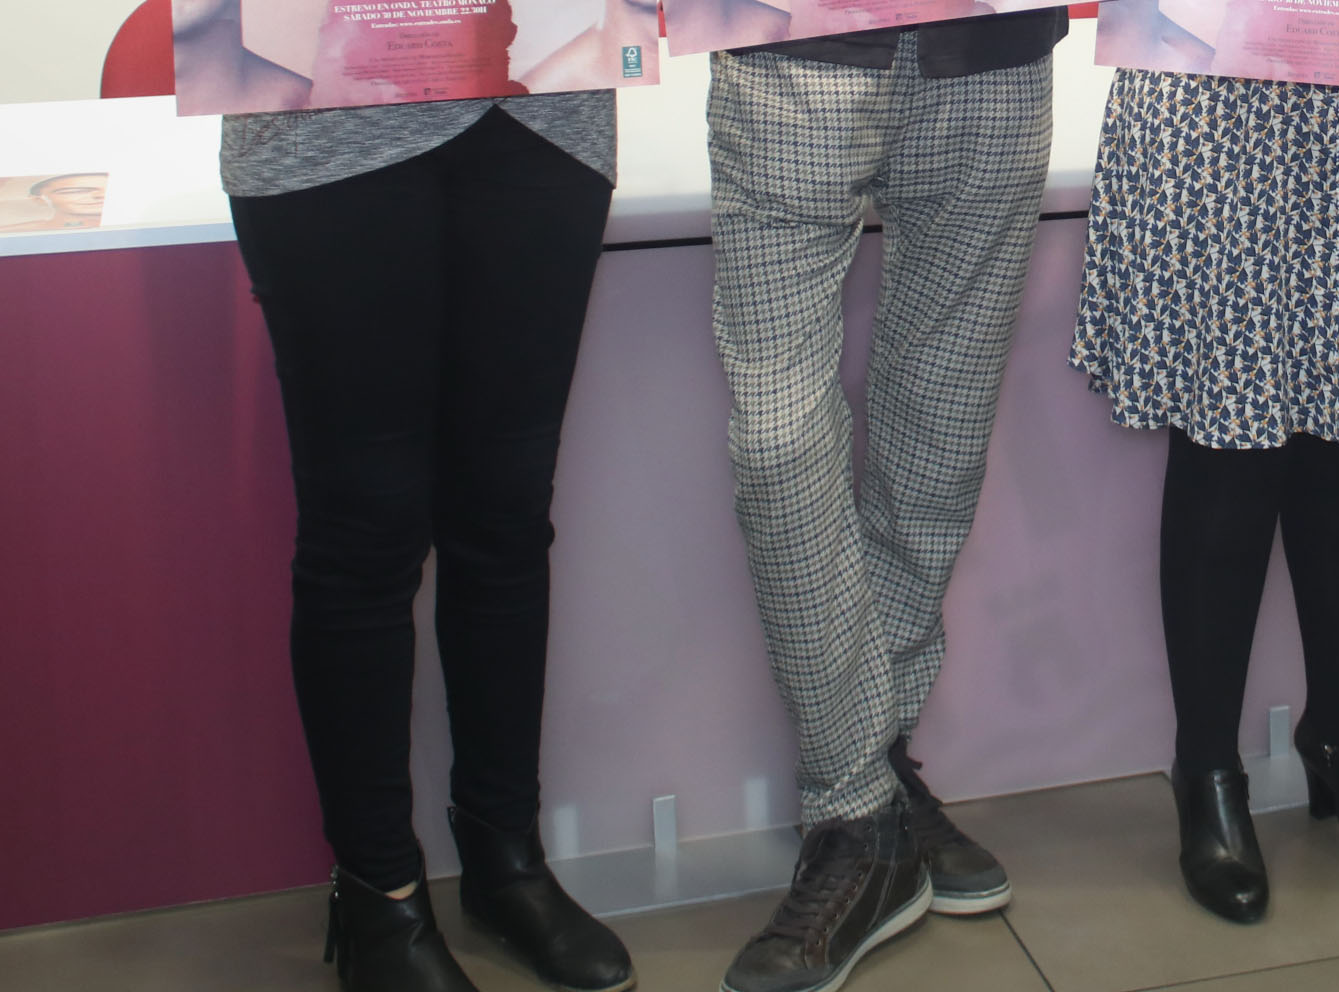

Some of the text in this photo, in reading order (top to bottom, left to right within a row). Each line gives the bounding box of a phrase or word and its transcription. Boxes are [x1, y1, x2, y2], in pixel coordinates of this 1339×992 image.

[334, 2, 376, 13] ESTRENO
[377, 2, 389, 11] EN
[392, 10, 405, 18] DE
[406, 6, 458, 18] NOVIEMBRE
